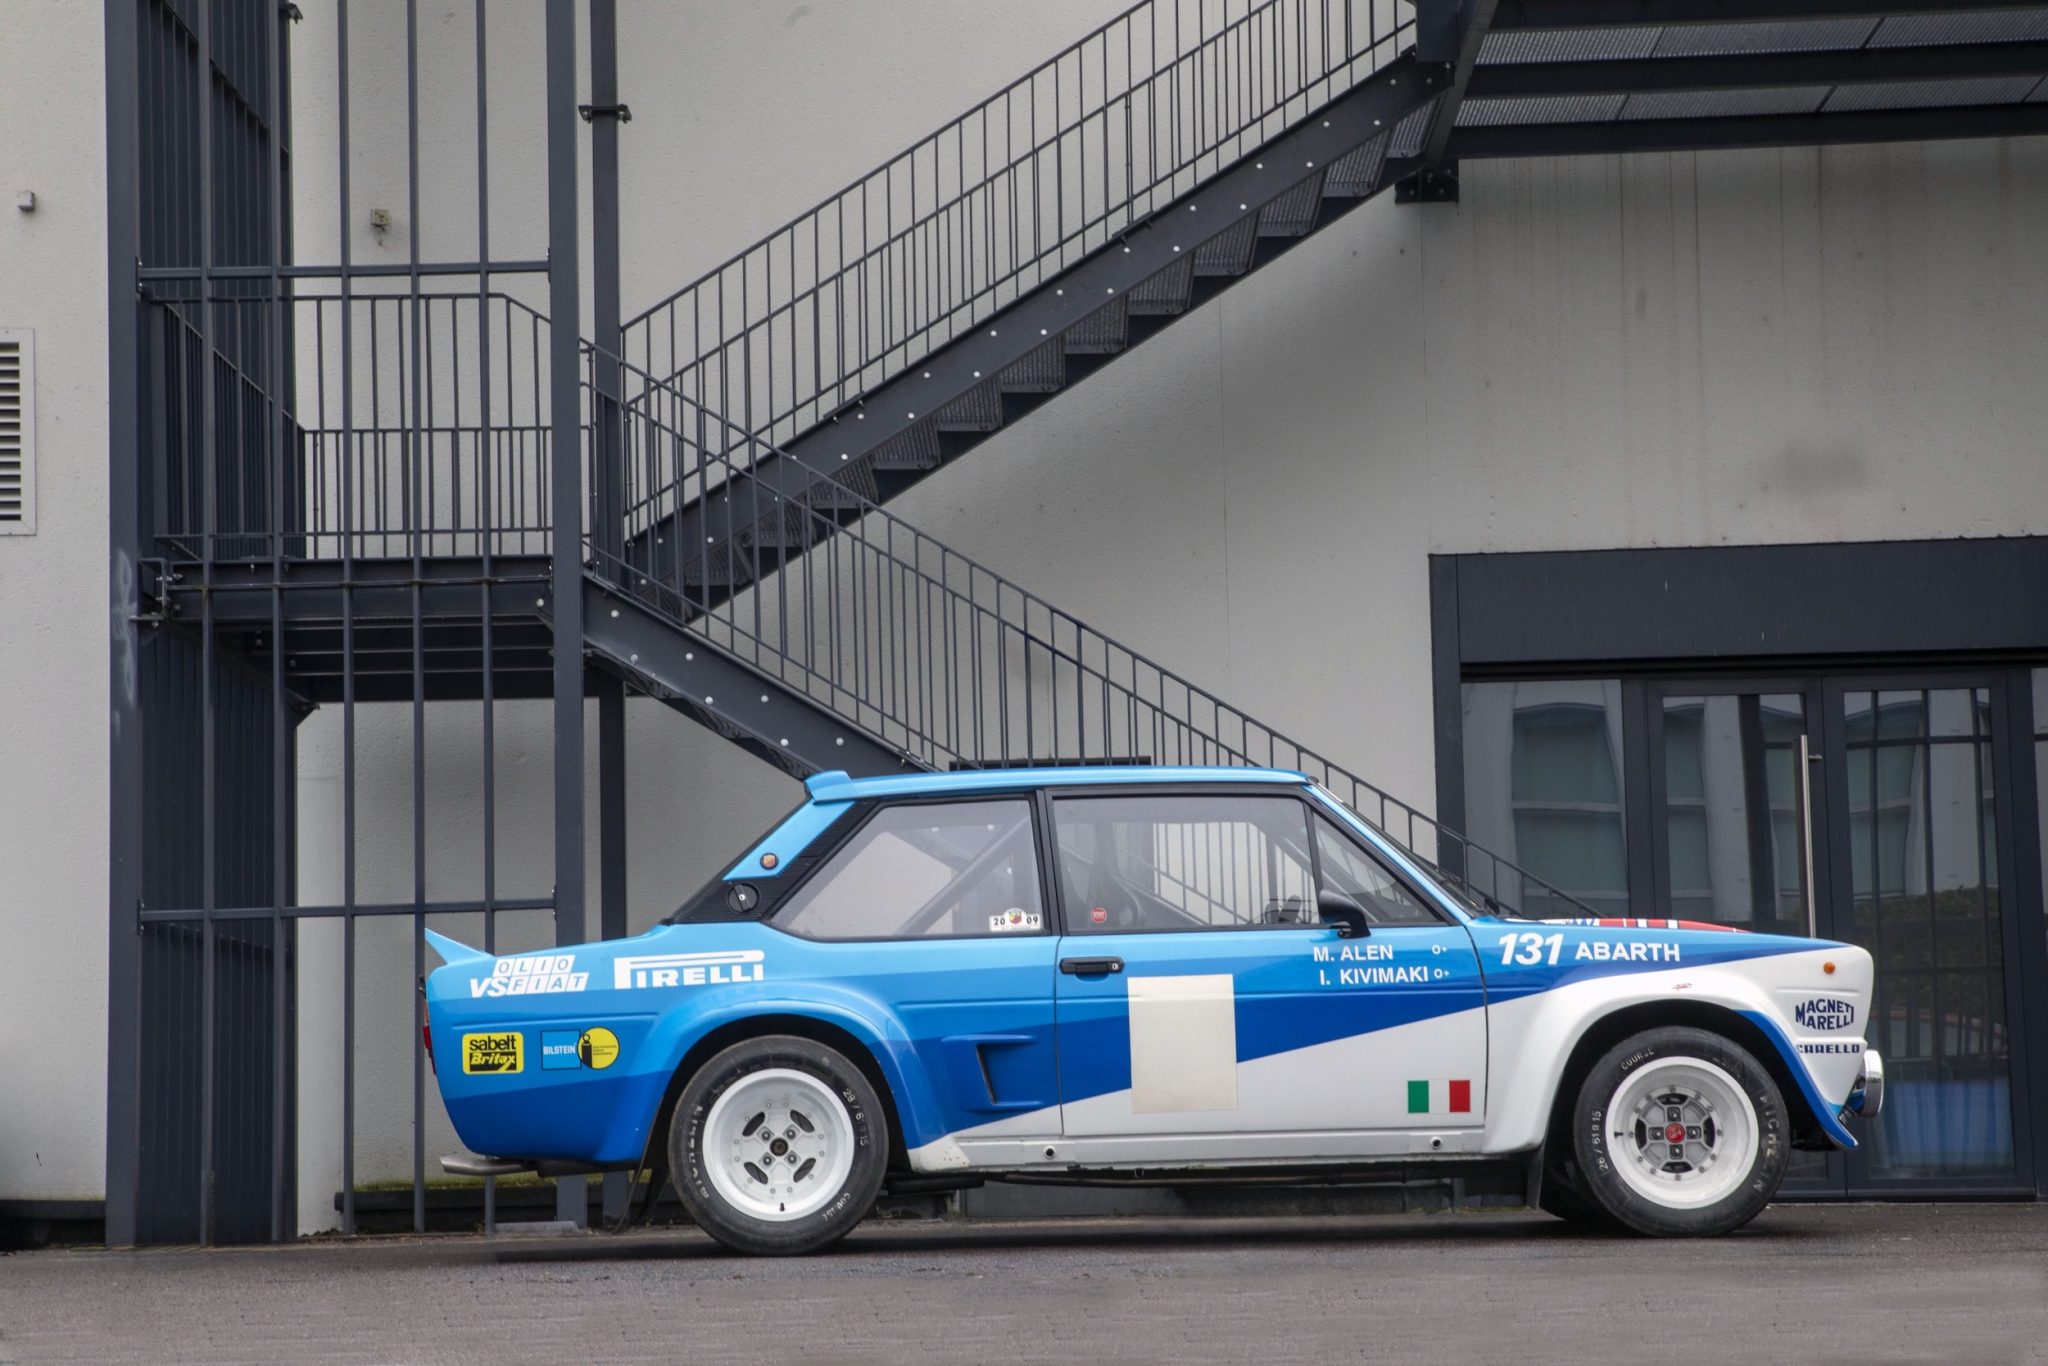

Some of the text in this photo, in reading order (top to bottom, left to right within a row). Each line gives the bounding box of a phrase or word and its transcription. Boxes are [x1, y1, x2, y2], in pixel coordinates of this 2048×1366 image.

[1313, 945, 1335, 962] M.
[1340, 944, 1394, 961] ALEN
[1499, 932, 1681, 966] 131 ABARTH
[496, 956, 571, 975] OLIO
[614, 950, 765, 989] PIRELLI
[1319, 969, 1331, 986] I.
[1340, 966, 1429, 985] KIVIMAKI
[1795, 999, 1854, 1015] MAGNETI
[1795, 1014, 1854, 1031] MARELLI
[469, 1034, 517, 1051] sabelt
[543, 1045, 576, 1055] BILSTEIN
[471, 1051, 516, 1067] Britax
